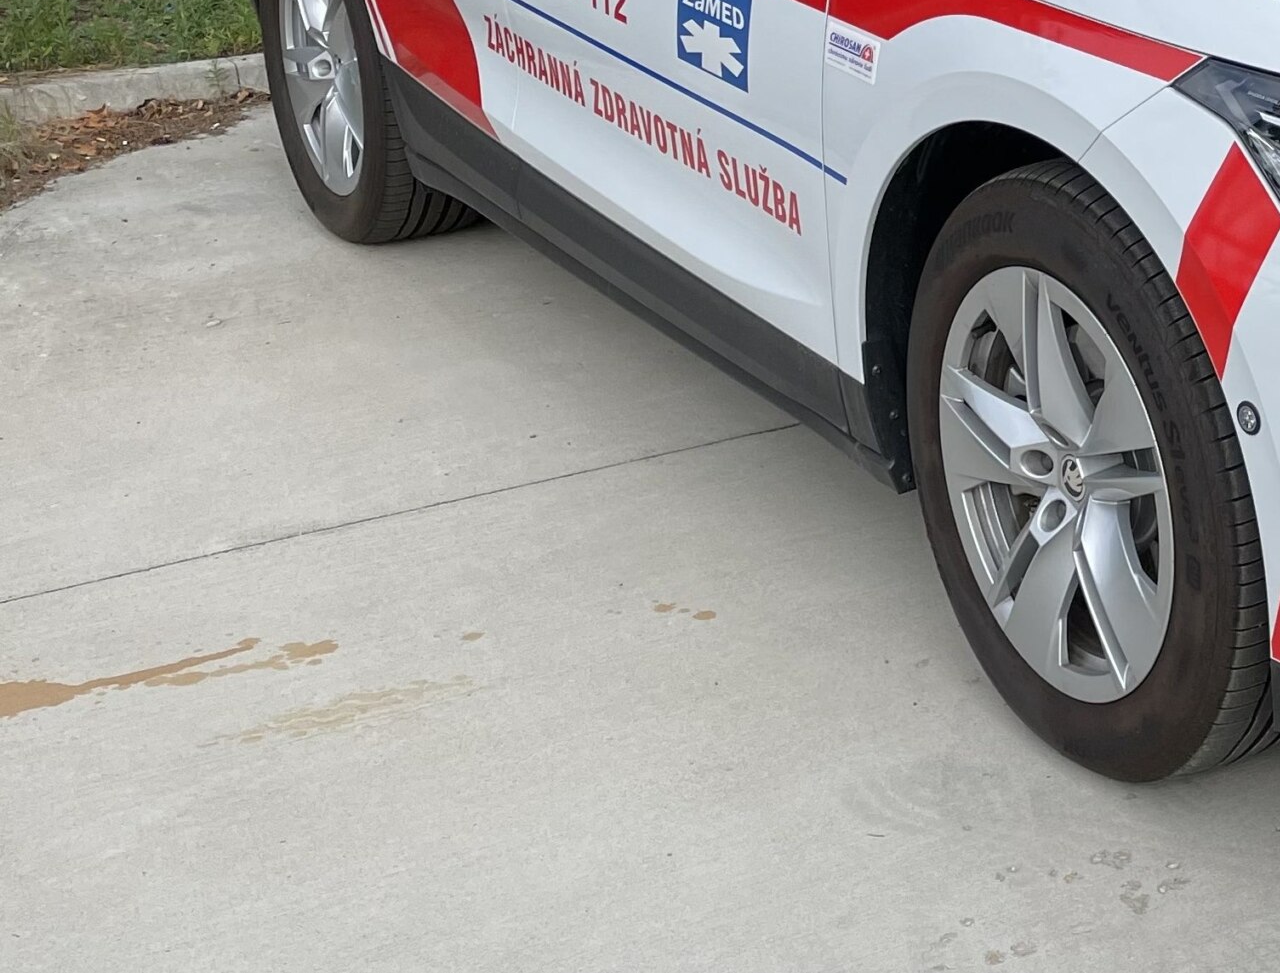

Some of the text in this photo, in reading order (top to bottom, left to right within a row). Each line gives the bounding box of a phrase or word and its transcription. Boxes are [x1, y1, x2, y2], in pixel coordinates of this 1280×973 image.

[829, 31, 863, 54] CHIROSAN
[483, 13, 803, 236] ZÁCHRANNÁ ZDRAVOTNÁ SLUŽBA
